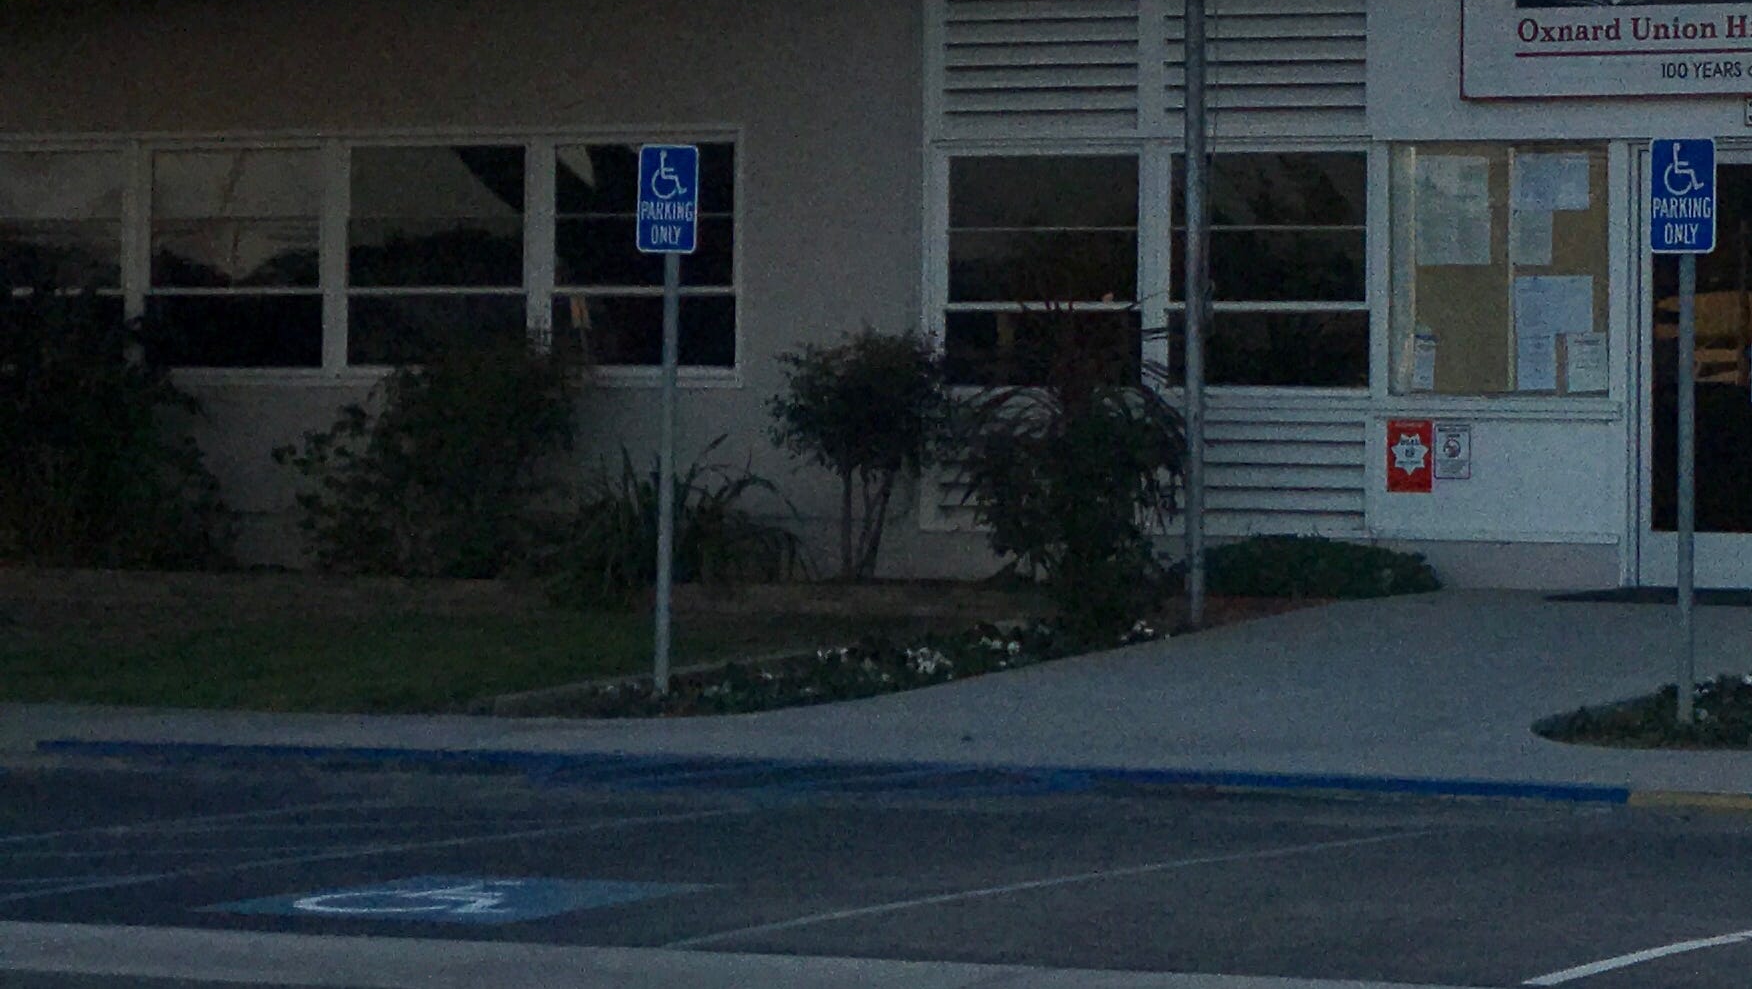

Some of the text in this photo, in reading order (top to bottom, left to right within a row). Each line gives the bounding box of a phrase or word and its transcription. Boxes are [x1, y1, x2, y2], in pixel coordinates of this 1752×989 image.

[1517, 17, 1621, 43] Oxnard
[1630, 16, 1718, 41] Union
[1661, 62, 1688, 79] 100
[1694, 61, 1742, 78] YEARS
[640, 200, 693, 222] PARKING
[1653, 197, 1711, 219] PARKING
[650, 224, 681, 246] ONLY
[1664, 222, 1699, 245] ONLY
